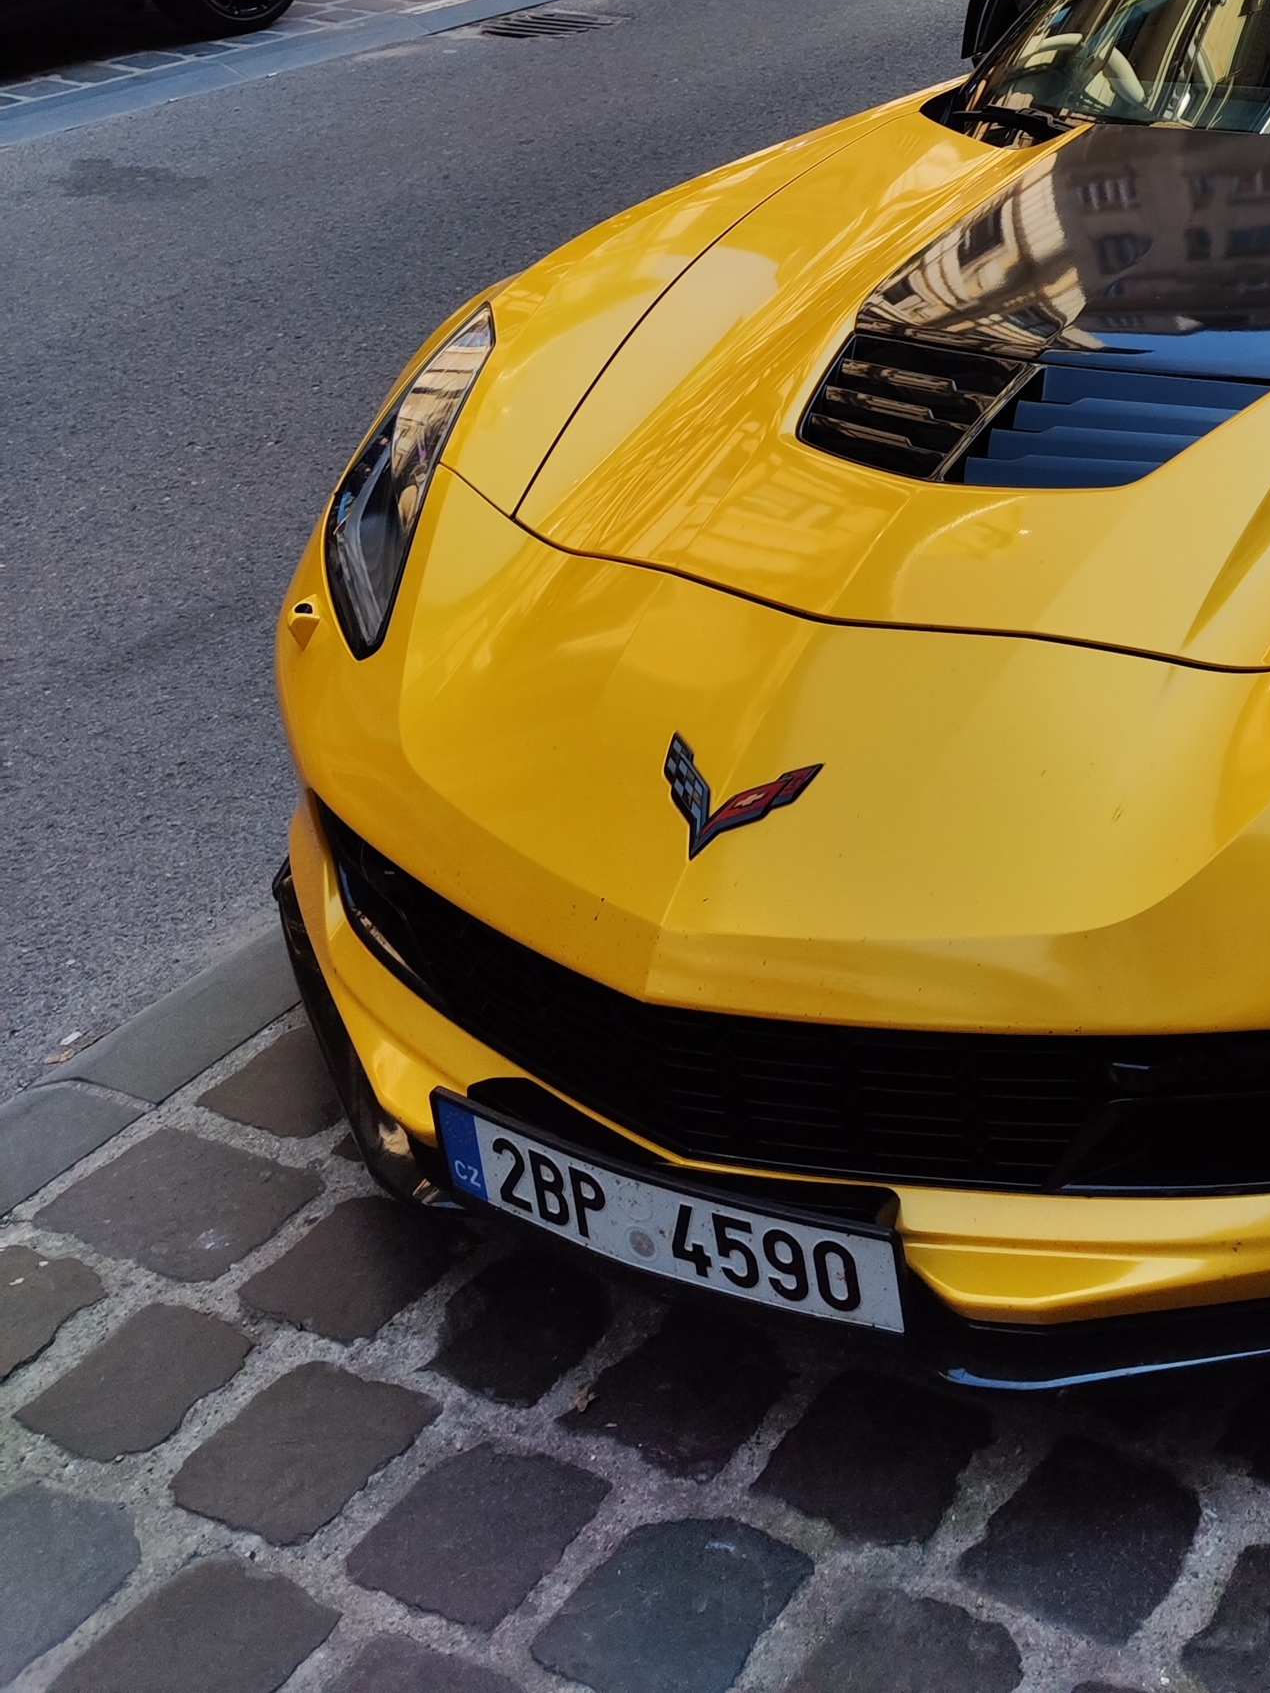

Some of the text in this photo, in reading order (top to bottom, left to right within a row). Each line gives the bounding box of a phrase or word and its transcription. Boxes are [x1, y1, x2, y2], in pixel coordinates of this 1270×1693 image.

[454, 1160, 481, 1188] CZ
[492, 1137, 861, 1312] 2BP 4590
